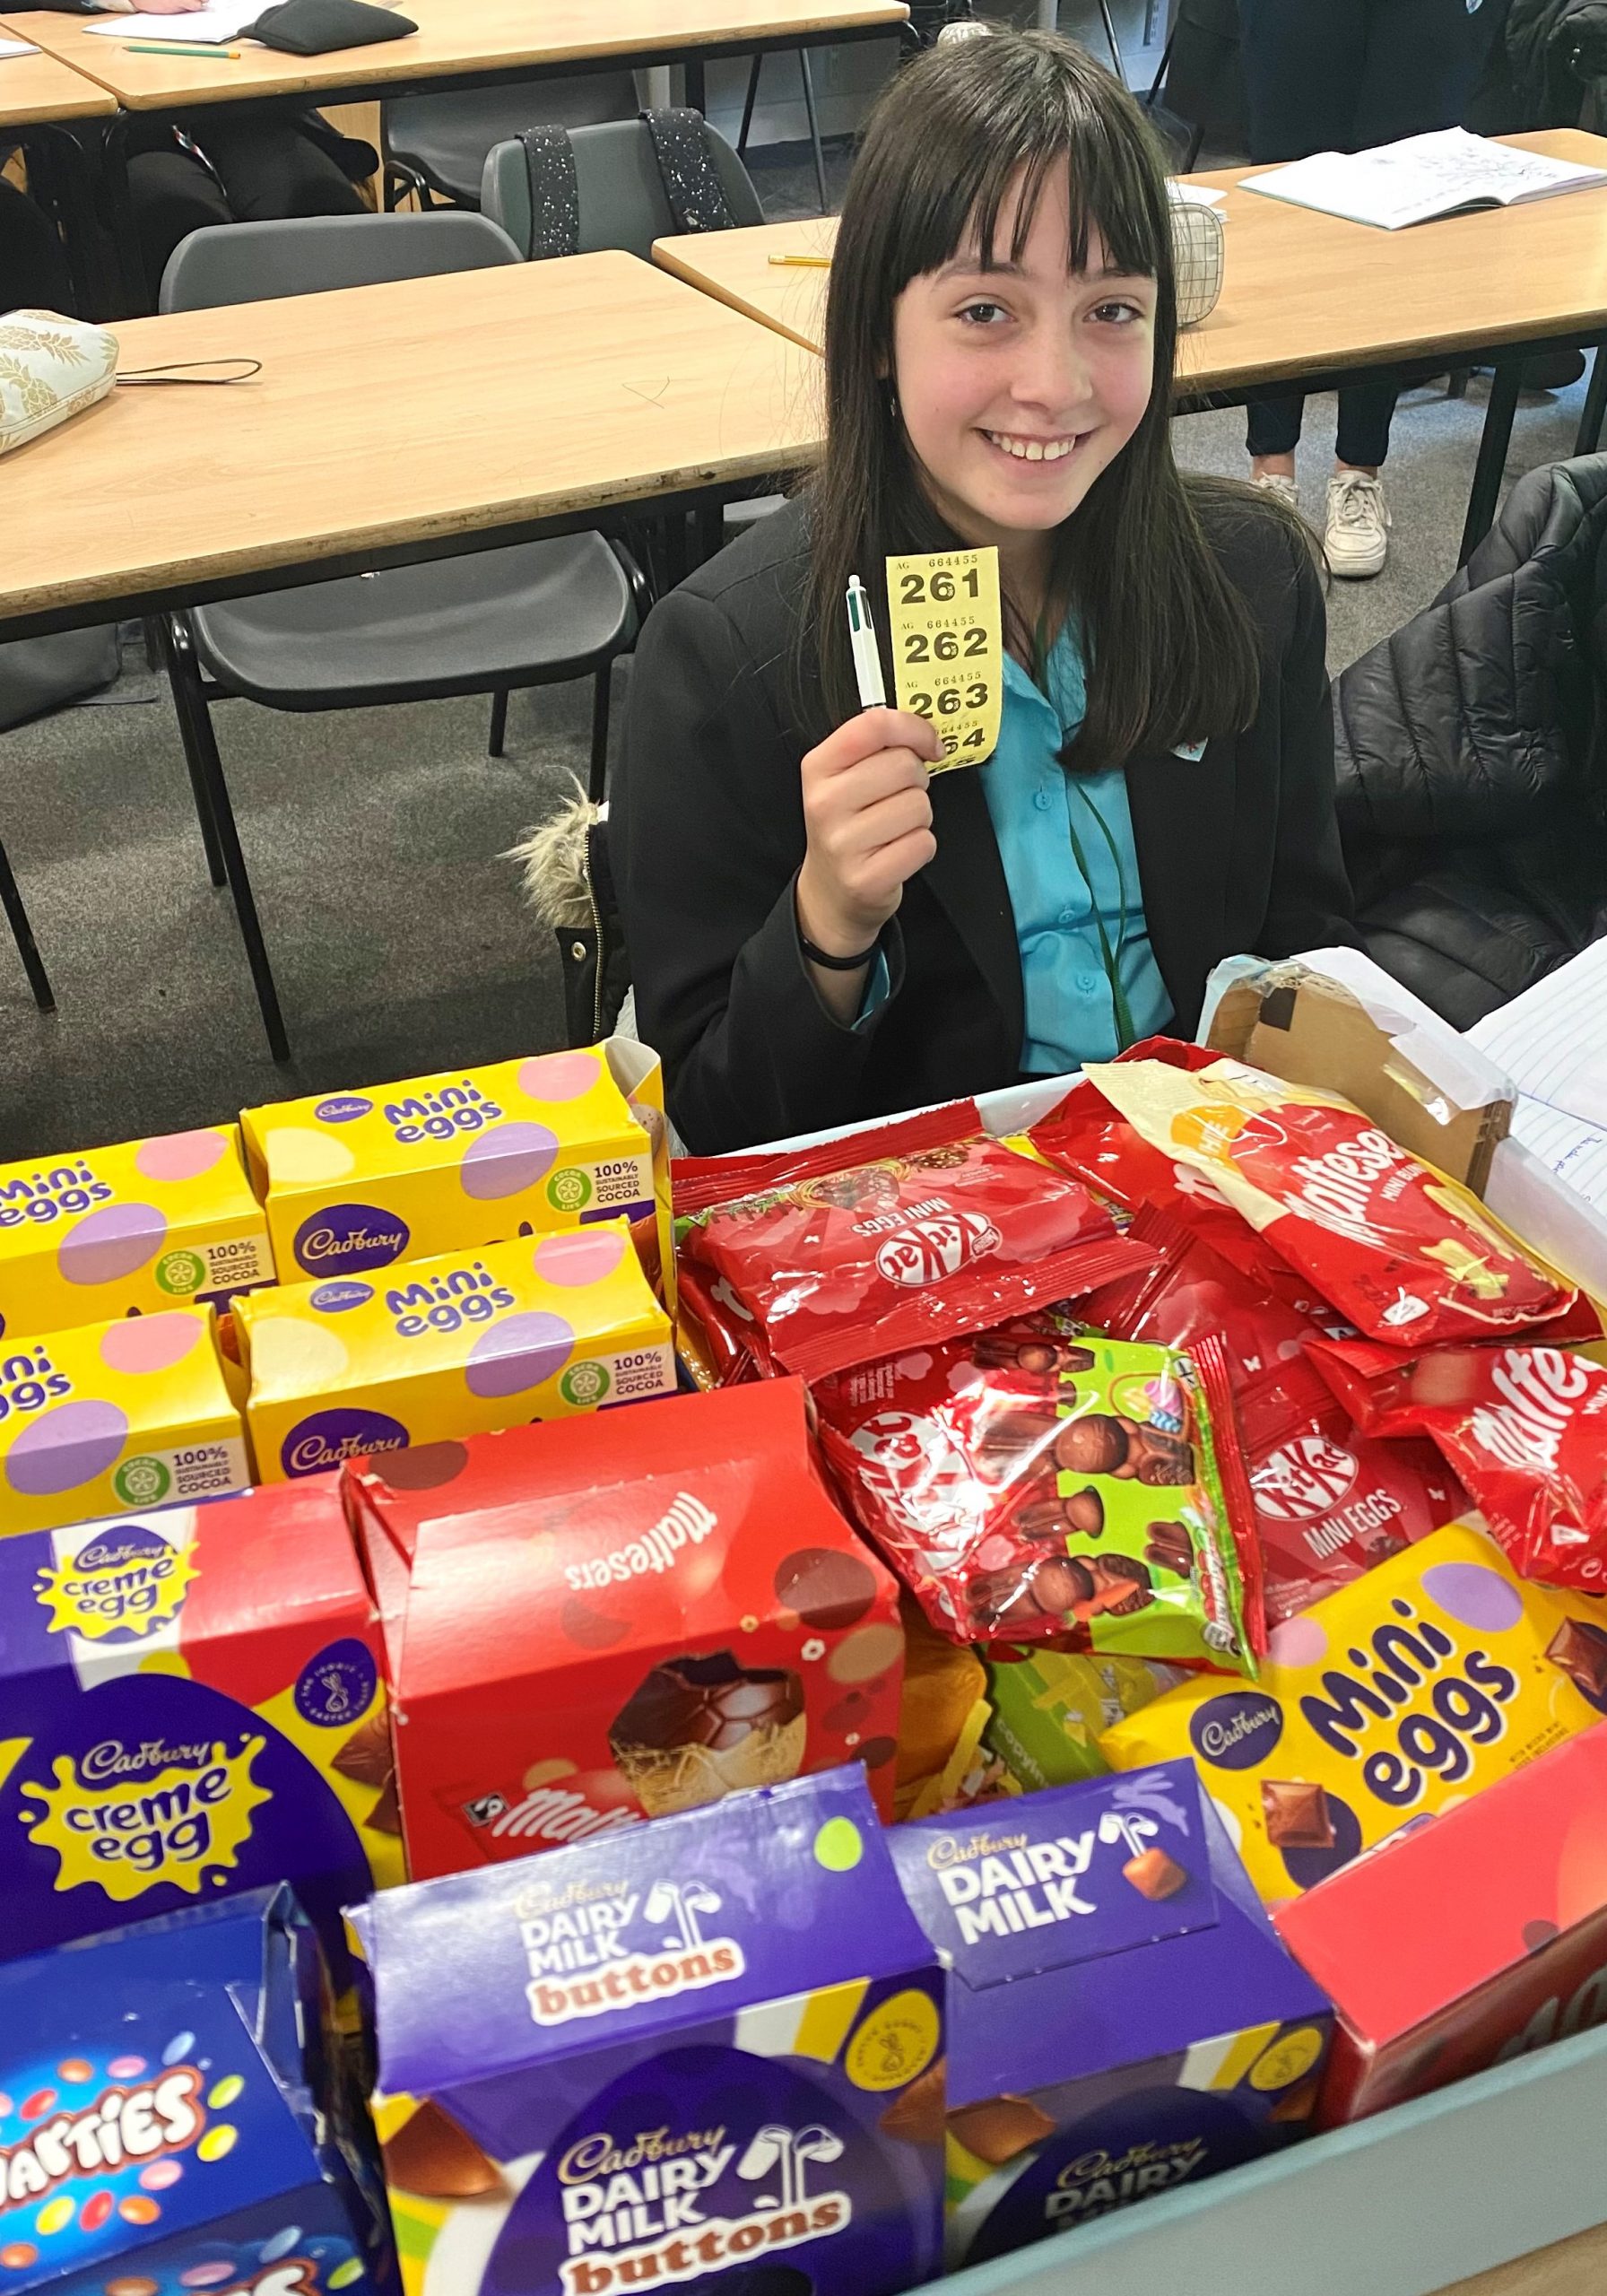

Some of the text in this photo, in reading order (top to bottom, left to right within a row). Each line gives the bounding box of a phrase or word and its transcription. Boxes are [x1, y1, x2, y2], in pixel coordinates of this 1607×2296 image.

[928, 554, 978, 568] 664455
[900, 569, 979, 604] 261
[926, 616, 976, 629] 664455
[905, 628, 987, 664] 262
[934, 672, 982, 686] 664455
[908, 683, 988, 719] 263
[935, 720, 978, 735] 64455
[942, 728, 986, 755] 64
[318, 1100, 371, 1119] Cadbury
[384, 1080, 482, 1126] Mini
[395, 1104, 502, 1144] eggs
[0, 1161, 92, 1207] Mini
[594, 1161, 638, 1178] 100%
[596, 1180, 639, 1193] SOURCED
[1380, 1176, 1407, 1202] MINI
[0, 1182, 112, 1227] eggs
[597, 1188, 640, 1202] COCOA
[851, 1196, 952, 1238] MINI EGGS
[207, 1241, 256, 1260] 100%
[301, 1228, 403, 1262] Cadbury
[882, 1213, 980, 1281] KitKat
[213, 1269, 260, 1284] COCOA
[386, 1262, 493, 1315] Mini
[395, 1285, 515, 1337] eggs
[0, 1345, 51, 1386] ni
[613, 1351, 662, 1370] 100%
[616, 1370, 664, 1385] SOURCED
[0, 1374, 71, 1420] gs
[616, 1379, 664, 1395] COCOA
[173, 1446, 228, 1466] 100%
[291, 1433, 402, 1471] Cadbury
[178, 1476, 231, 1494] COCOA
[1257, 1439, 1352, 1518] KitKat
[565, 1491, 718, 1591] Maltesers
[1302, 1489, 1401, 1559] MINI EGGS
[78, 1543, 167, 1569] Cadbury
[64, 1558, 174, 1597] creme
[78, 1584, 157, 1620] egg
[1300, 1598, 1454, 1758] Mini
[1202, 1700, 1280, 1756] Cadbury
[1363, 1650, 1516, 1806] eggs
[81, 1737, 214, 1780] Cadbury
[66, 1766, 232, 1831] creme
[91, 1809, 211, 1872] egg
[926, 1831, 1029, 1870] Cadbury
[937, 1831, 1097, 1907] DAIRY
[513, 1880, 630, 1918] Cadbury
[520, 1889, 640, 1948] DAIRY
[953, 1878, 1098, 1945] MILK
[526, 1931, 628, 1978] MILK
[534, 1945, 735, 2017] buttons
[0, 2071, 196, 2202] ARTIES
[558, 2124, 727, 2186] Cadbury
[1055, 2137, 1204, 2188] Cadbury
[561, 2145, 736, 2222] DAIRY
[1045, 2146, 1209, 2221] DAIRY
[567, 2191, 707, 2256] MILK
[569, 2199, 841, 2296] buttons
